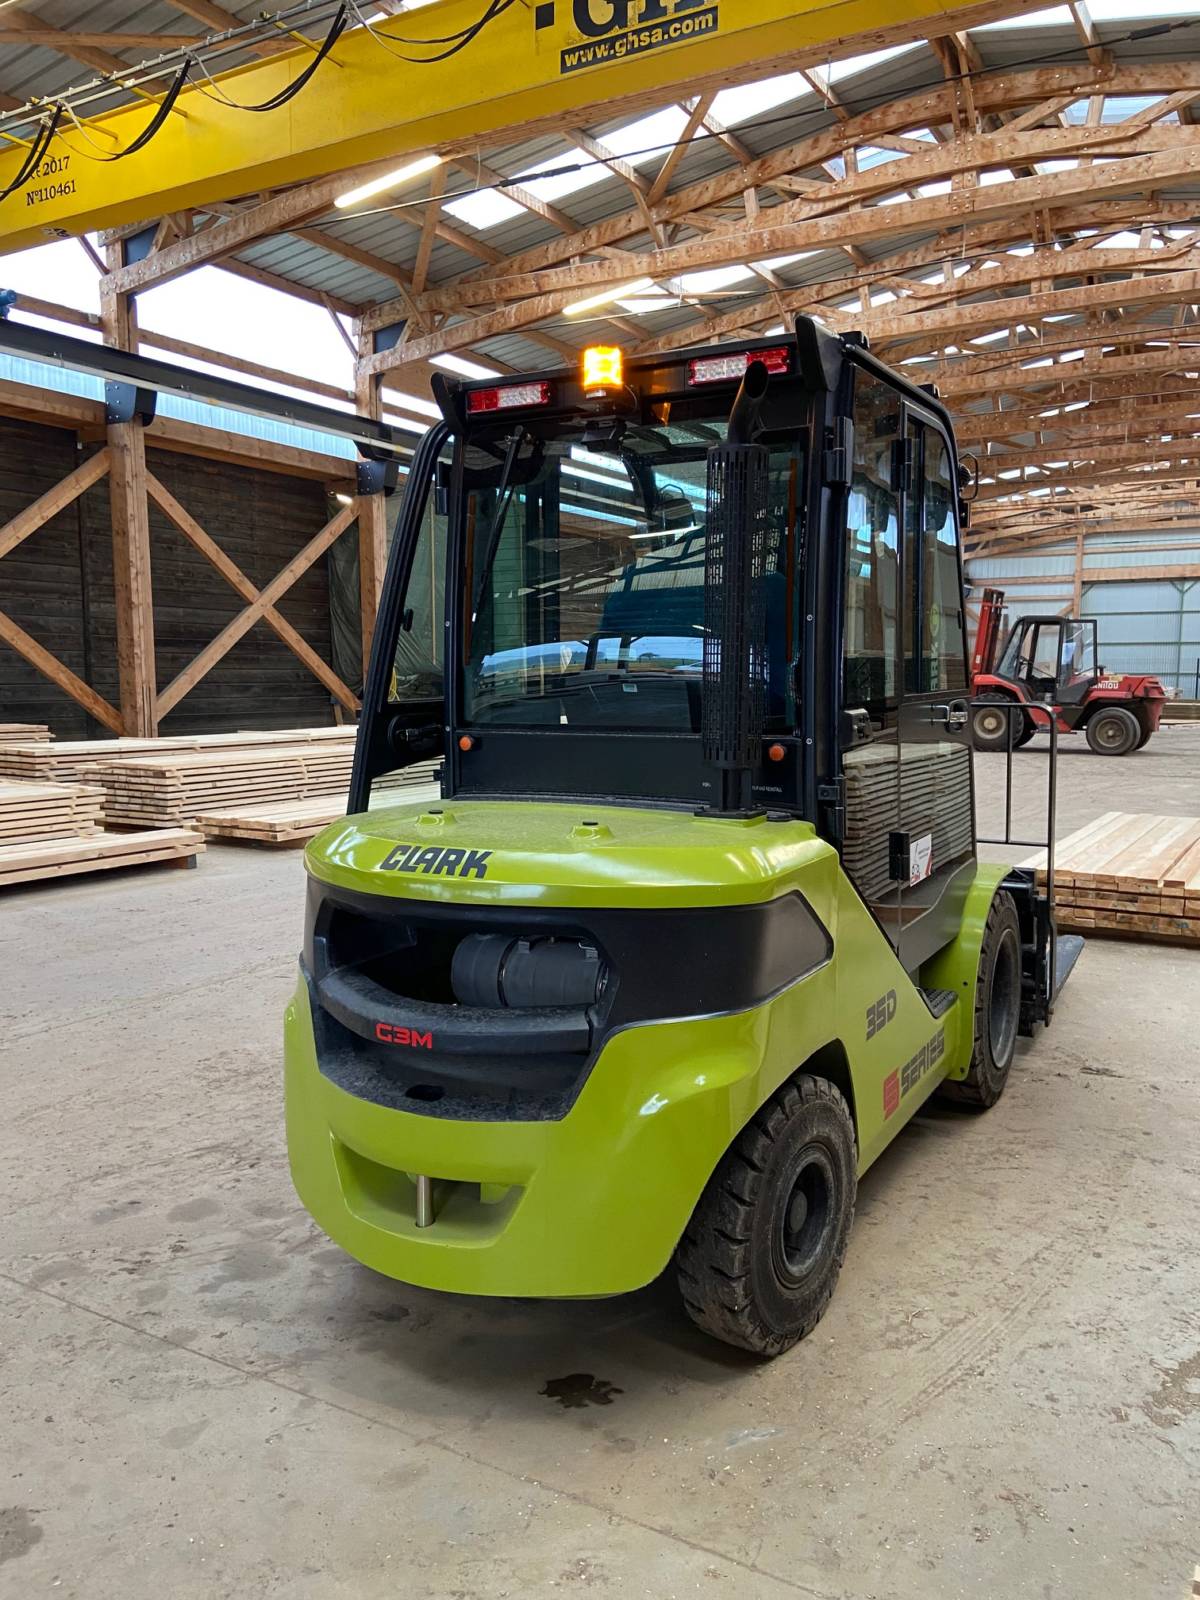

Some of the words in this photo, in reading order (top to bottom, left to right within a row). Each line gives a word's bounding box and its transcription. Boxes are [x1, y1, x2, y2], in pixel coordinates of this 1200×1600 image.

[564, 13, 713, 66] www.ghsa.com
[43, 156, 70, 177] 2017
[380, 845, 493, 879] CLARK
[866, 988, 897, 1041] 35D
[901, 1026, 945, 1098] SERIES
